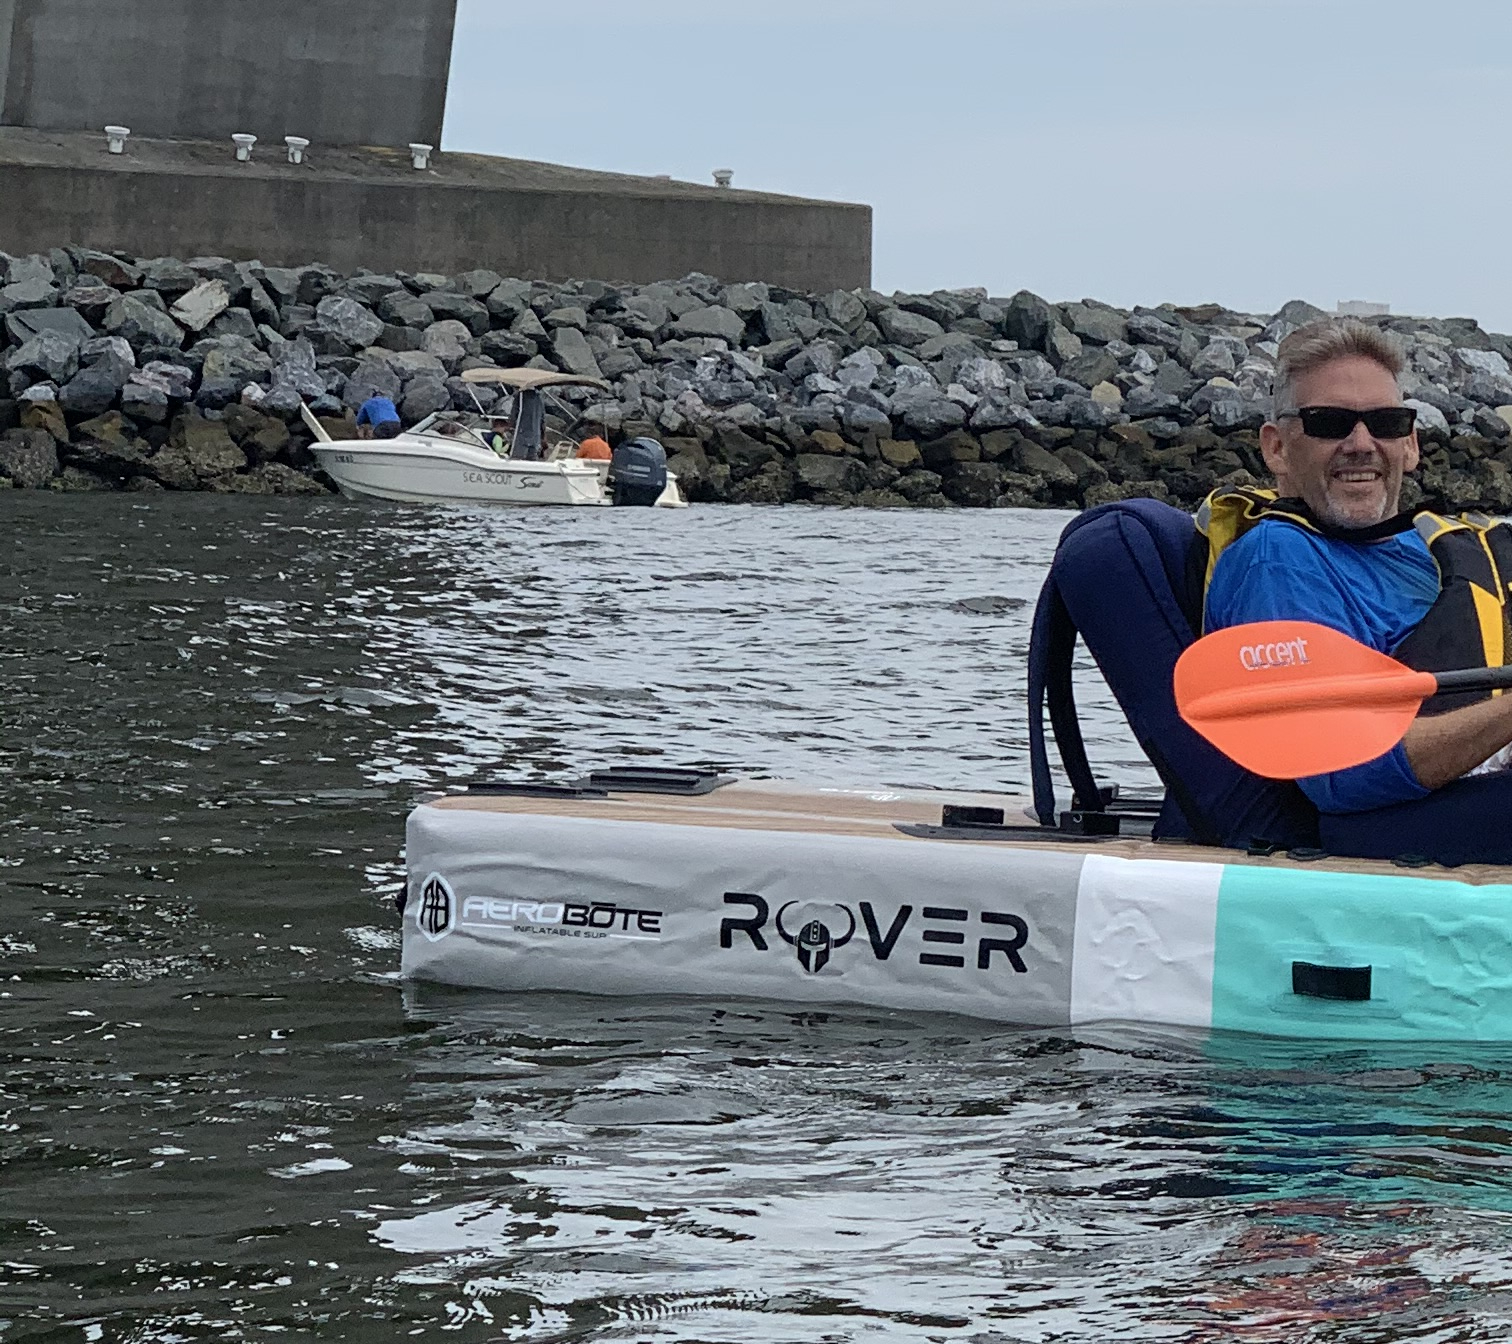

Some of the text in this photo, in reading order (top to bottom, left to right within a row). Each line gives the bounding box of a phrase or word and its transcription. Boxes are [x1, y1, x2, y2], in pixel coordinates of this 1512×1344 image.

[463, 472, 513, 485] SEA SCOUT
[1240, 637, 1309, 671] accent
[513, 925, 607, 939] INFLATABLE SUP
[719, 892, 1030, 974] ROVER
